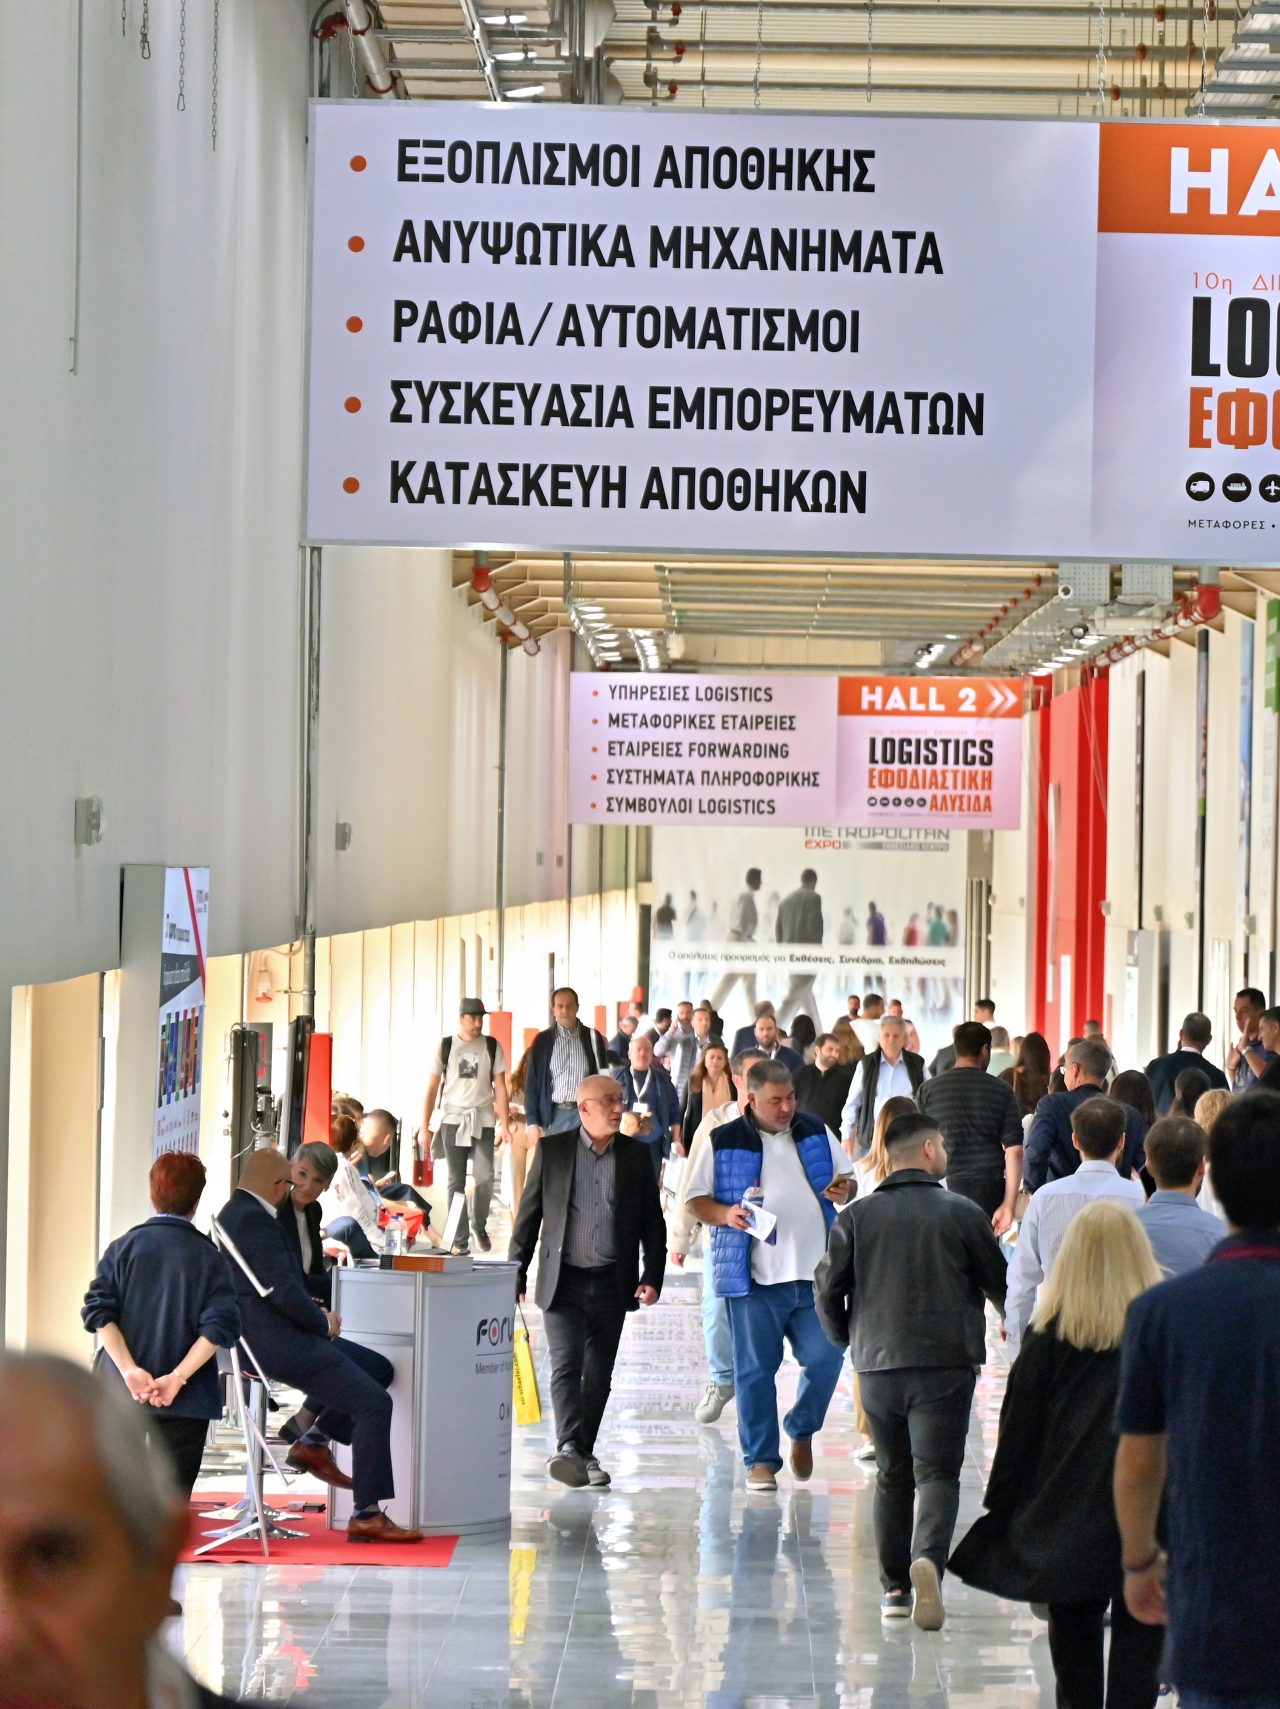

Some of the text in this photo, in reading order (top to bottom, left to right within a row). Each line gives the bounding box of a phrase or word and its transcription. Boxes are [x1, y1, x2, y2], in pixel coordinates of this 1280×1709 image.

[397, 139, 875, 192] ΕΞΟΠΛΙΣΜΟΙ ΑΠΟΘΗΚΗΣ
[393, 220, 943, 274] ΑΝΥΨΩΤΙΚΑ ΜΗΧΑΝΗΜΑΤΑ
[1194, 272, 1233, 295] 10η
[394, 300, 859, 352] ΡΑΦΙΑ/ΑΥΤΟΜΑΤΙΣΜΟΙ
[390, 380, 984, 435] ΣΥΣΚΕΥΑΣΙΑ ΕΜΠΟΡΕΥΜΑΤΩΝ
[390, 461, 866, 513] ΚΑΤΑΣΚΕΥΗ ΑΠΟΘΗΚΩΝ
[1189, 520, 1265, 529] ΜΕΤΑΦΟΡΕΣ
[609, 685, 772, 702] ΥΠΗΡΕΣΙΕΣ LOGISTICS
[862, 686, 976, 711] HALL 2
[609, 713, 796, 730] ΜΕΤΑΦΟΡΙΚΕΣ ΕΤΑΙΡΕΙΕΣ
[608, 741, 789, 758] ΕΤΑΙΡΕΙΕΣ FORWARDING
[869, 738, 993, 766] LOGISTICS
[607, 769, 819, 787] ΣΥΣΤΗΜΑΤΑ ΠΛΗΡΟΦΟΡΙΚΗΣ
[869, 768, 992, 790] ΕΦΟΔΙΑΣΤΙΚΗ
[607, 797, 775, 814] ΣΥΜΒΟΥΛΟΙ LOGISTICS
[931, 794, 992, 812] ΑΛΥΣΙΔΑ
[804, 839, 842, 849] EXPO
